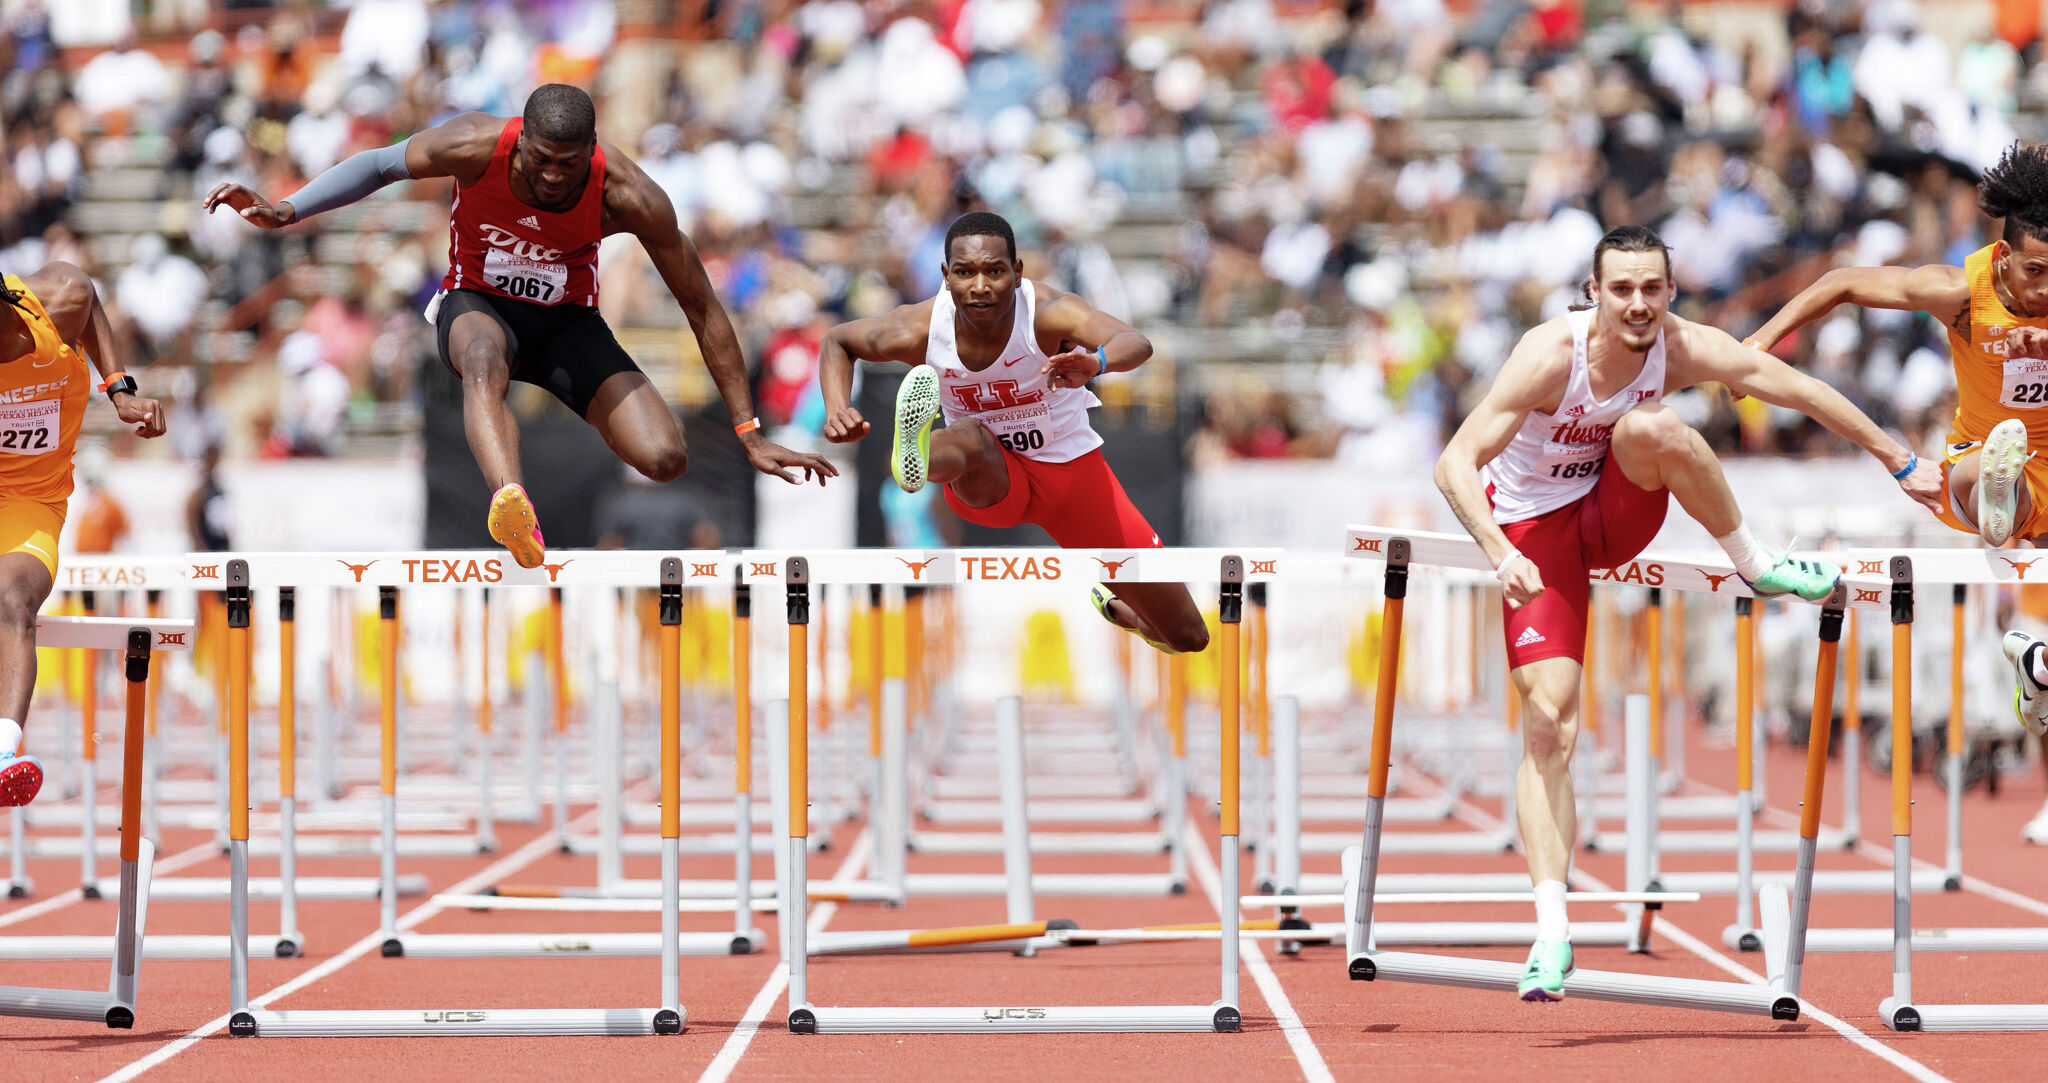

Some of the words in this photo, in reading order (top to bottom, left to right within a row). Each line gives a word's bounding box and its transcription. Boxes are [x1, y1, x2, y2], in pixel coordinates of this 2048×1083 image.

[495, 275, 555, 302] 2067
[28, 407, 59, 418] RELAYS
[986, 414, 1015, 424] TEXAS
[1016, 409, 1049, 420] RELAYS
[1003, 423, 1026, 431] TRUIST
[0, 427, 49, 449] 272
[1353, 537, 1383, 553] XII
[192, 564, 219, 579] XII
[402, 559, 502, 583] TEXAS
[691, 562, 719, 578] XII
[750, 562, 777, 577] XII
[960, 556, 1061, 580] TEXAS
[1250, 559, 1277, 574] XII
[1857, 560, 1884, 574] XII
[64, 565, 147, 585] TEXAS
[1853, 588, 1883, 604] XII
[157, 631, 186, 646] XII
[1515, 635, 1546, 647] adidas
[423, 1011, 487, 1023] UCS
[982, 1008, 1046, 1020] UCS
